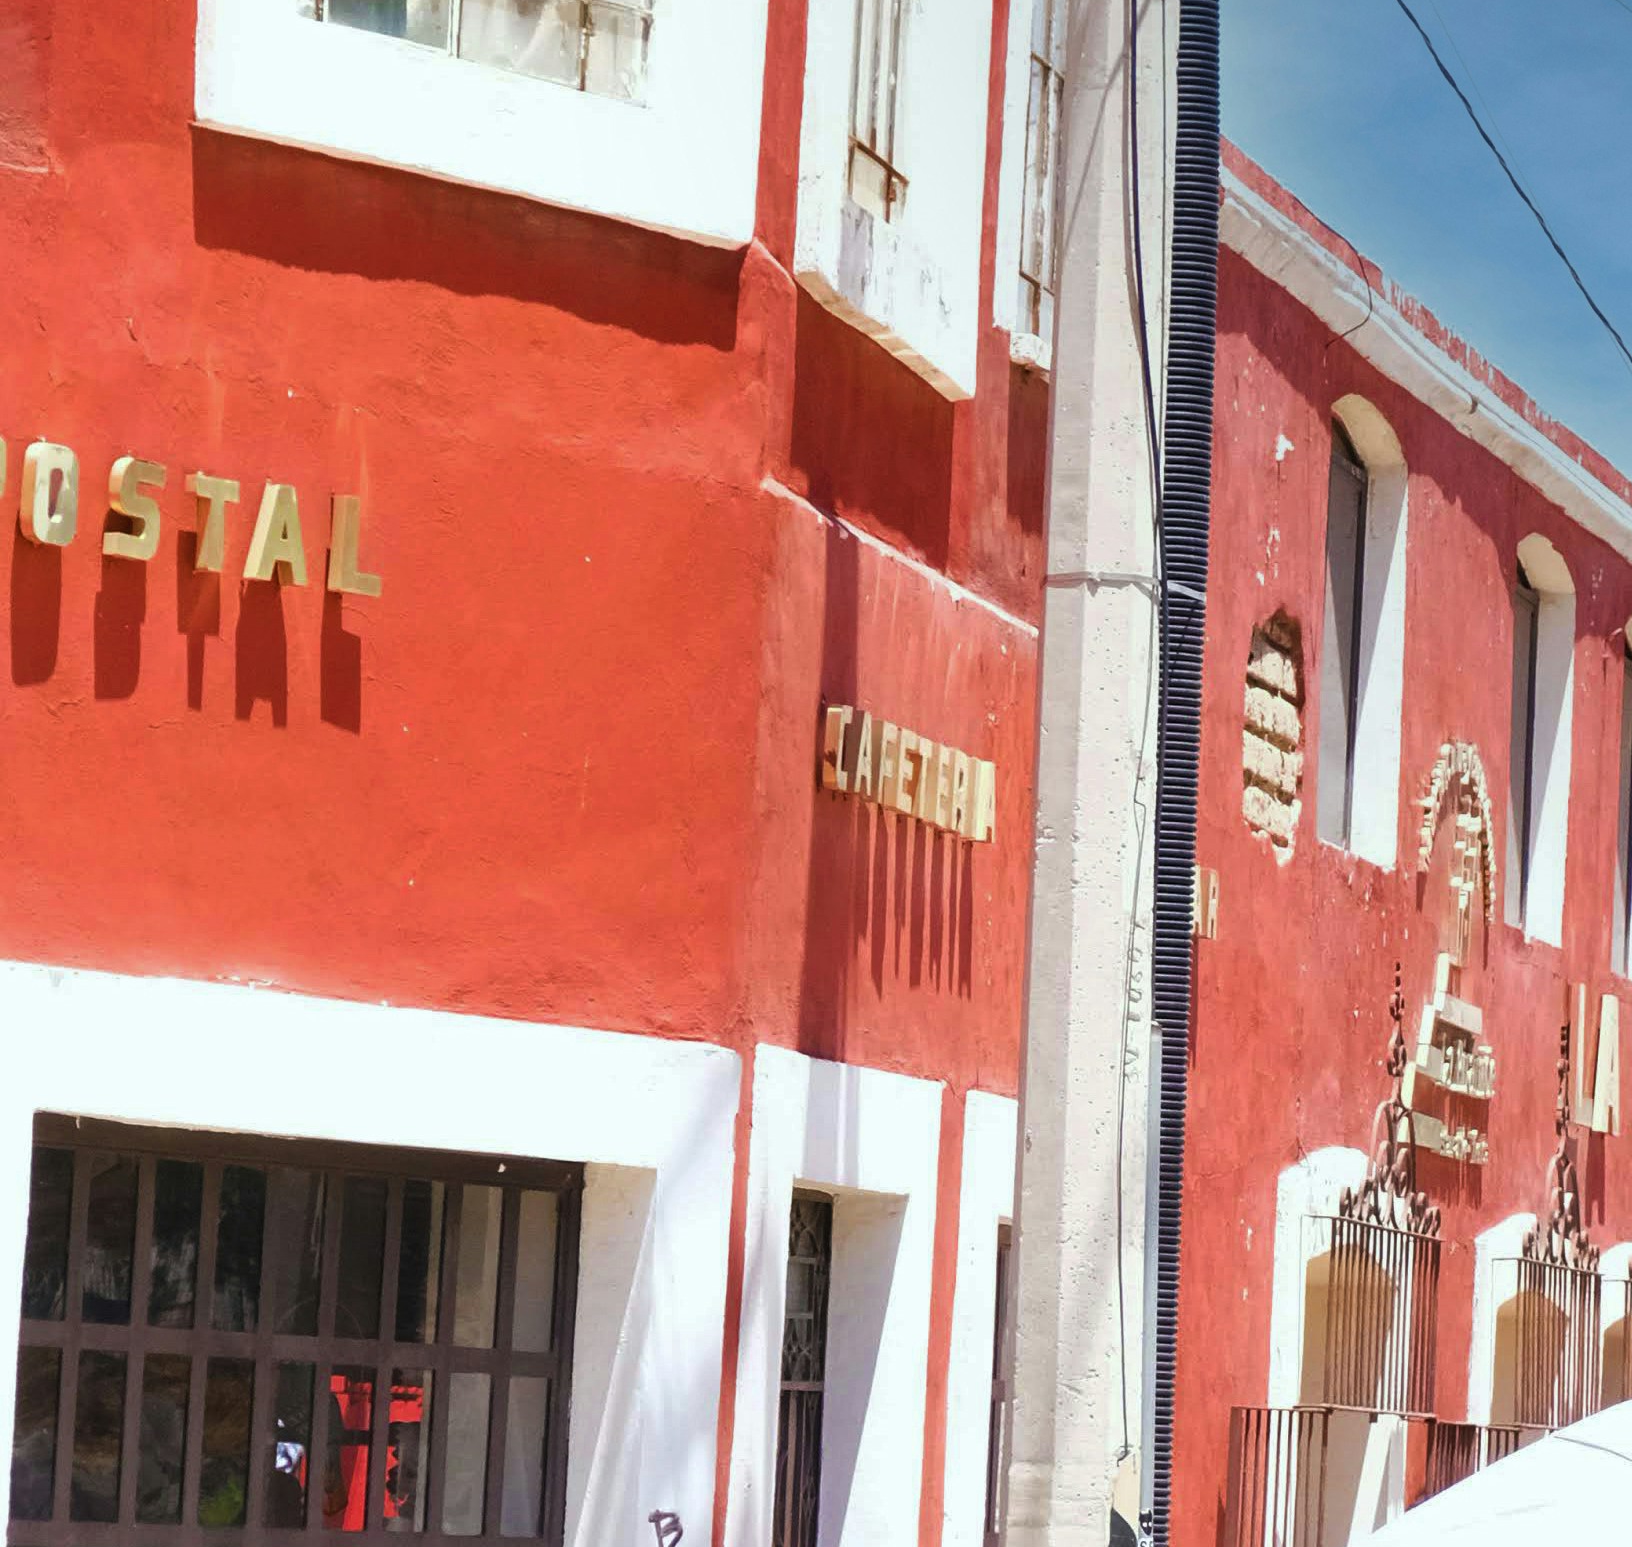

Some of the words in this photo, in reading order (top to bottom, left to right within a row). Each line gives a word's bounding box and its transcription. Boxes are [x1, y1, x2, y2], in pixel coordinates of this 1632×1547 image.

[0, 435, 382, 597] OSTAL
[823, 704, 996, 844] CAFETERIA
[1570, 981, 1621, 1138] LA
